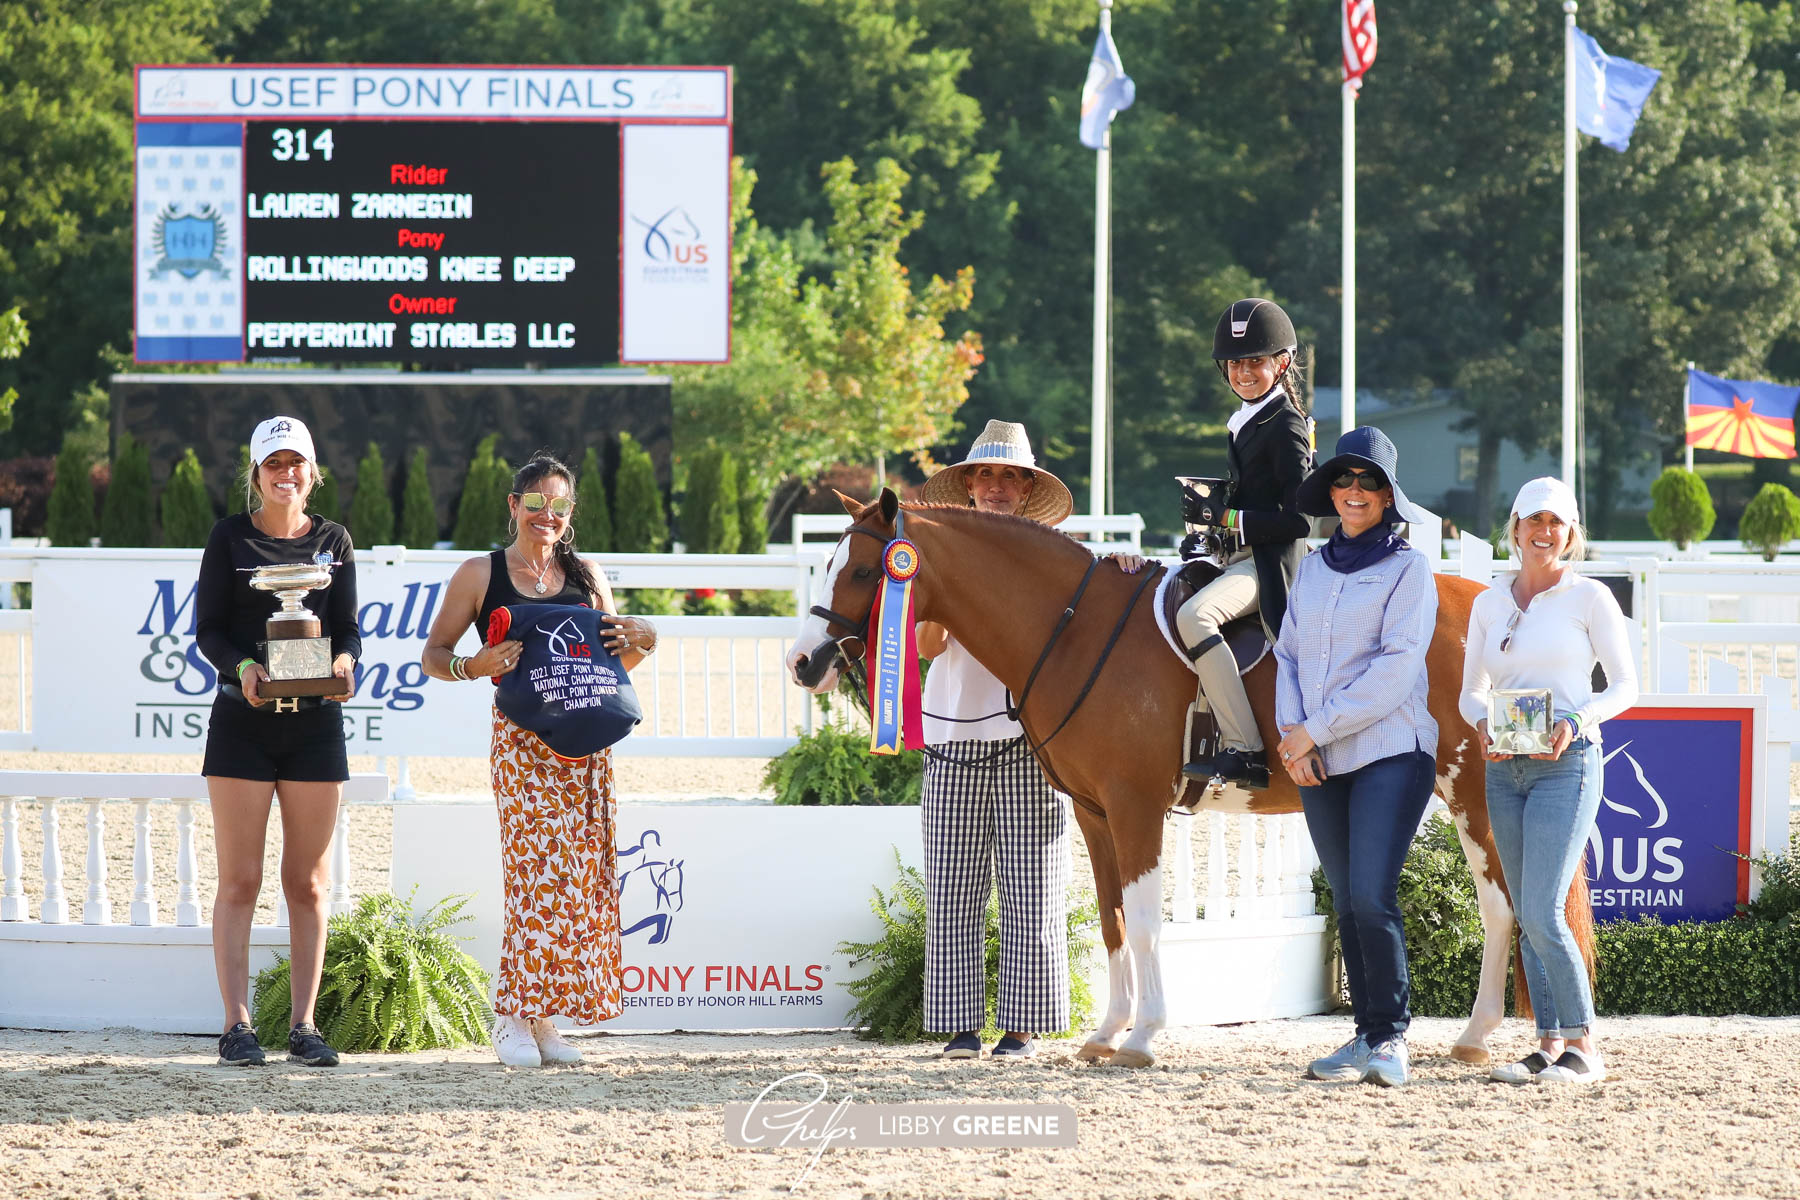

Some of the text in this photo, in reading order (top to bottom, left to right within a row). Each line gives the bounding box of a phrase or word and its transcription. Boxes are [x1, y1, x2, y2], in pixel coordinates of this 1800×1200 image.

[232, 77, 634, 108] USEF PONY FINALS
[271, 128, 334, 161] 314
[391, 164, 448, 185] Rider
[248, 193, 472, 219] LAUREN ZARNEGIN
[398, 229, 445, 251] Pony
[675, 244, 708, 264] US
[248, 256, 576, 282] ROLLINGWOODS KNEE DEEP
[389, 293, 457, 315] Owner
[248, 322, 576, 348] PEPPERMINT STABLES LLC
[551, 656, 592, 664] EQUESTRIAN
[569, 643, 592, 657] US
[530, 664, 617, 680] 2021 USEF PONY HUNTER
[534, 675, 618, 692] NATIONAL CHAMPIONSHIP
[542, 685, 618, 703] SMALL PONY HUNTER
[564, 696, 602, 711] CHAMPION
[1612, 837, 1684, 883] US
[1590, 889, 1684, 907] ESTRIAN
[622, 965, 695, 992] ONY
[623, 995, 823, 1007] SENTED BY HONOR HILL FARMS
